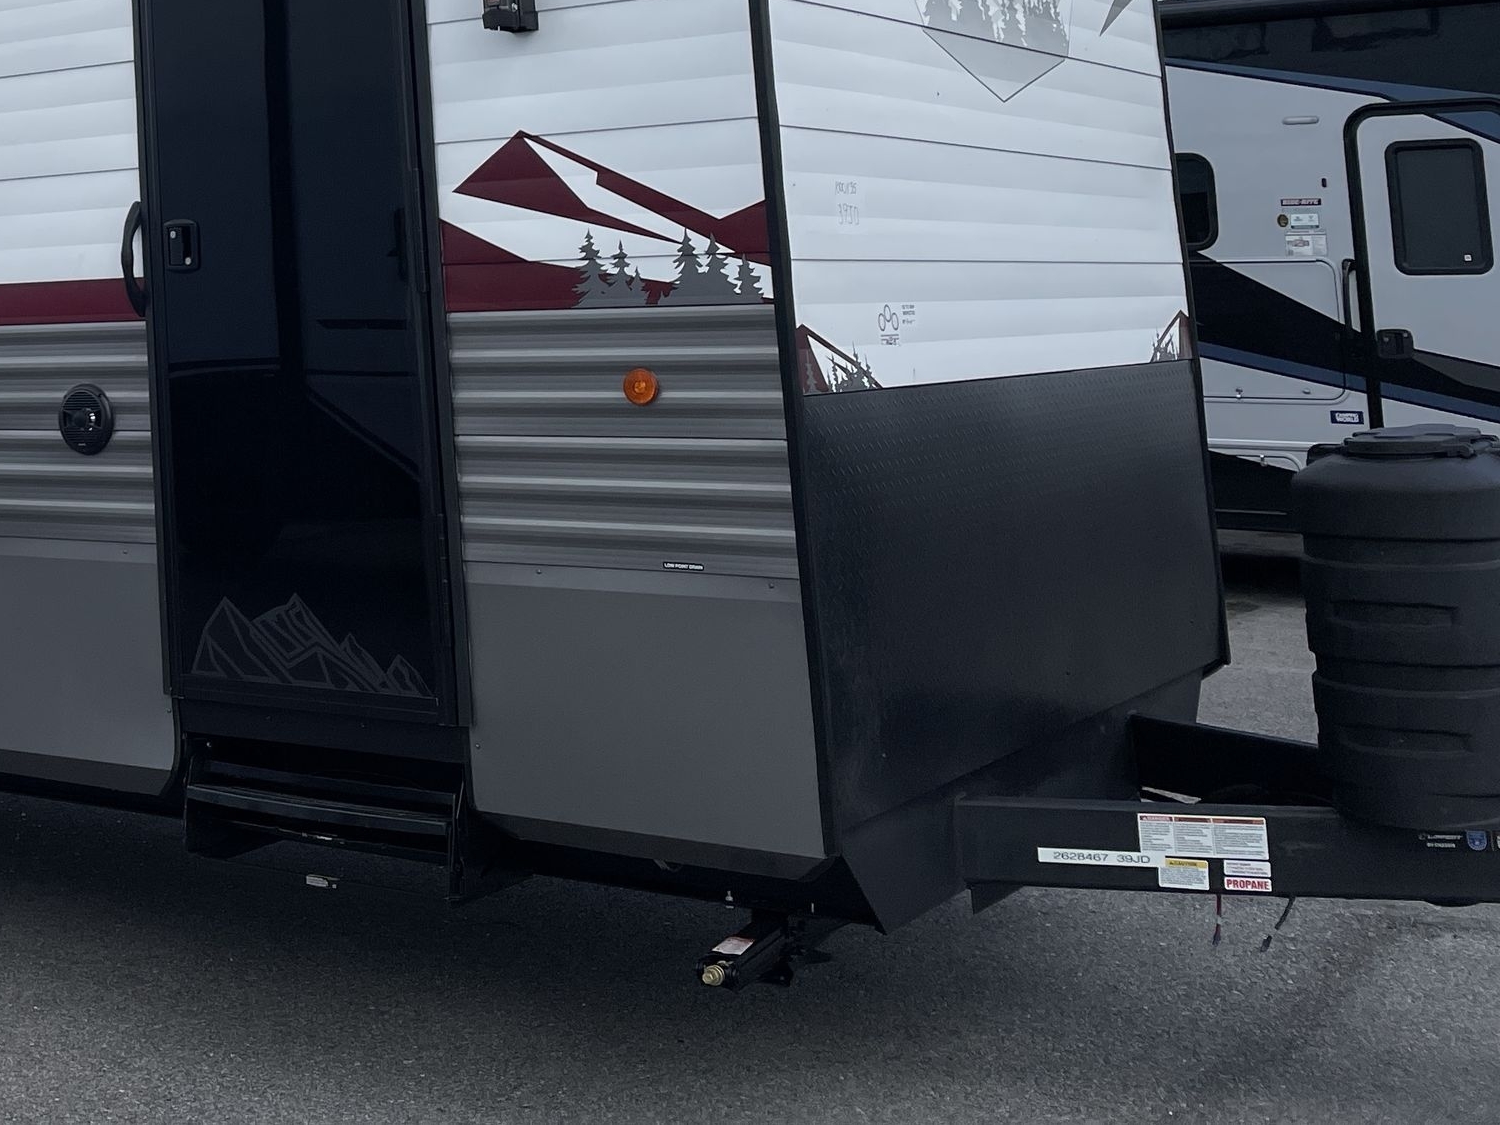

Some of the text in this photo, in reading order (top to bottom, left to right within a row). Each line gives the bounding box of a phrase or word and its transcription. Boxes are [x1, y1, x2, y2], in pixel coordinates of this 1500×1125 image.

[1053, 851, 1151, 864] 2628467 39JD
[1226, 878, 1270, 890] PROPANE
